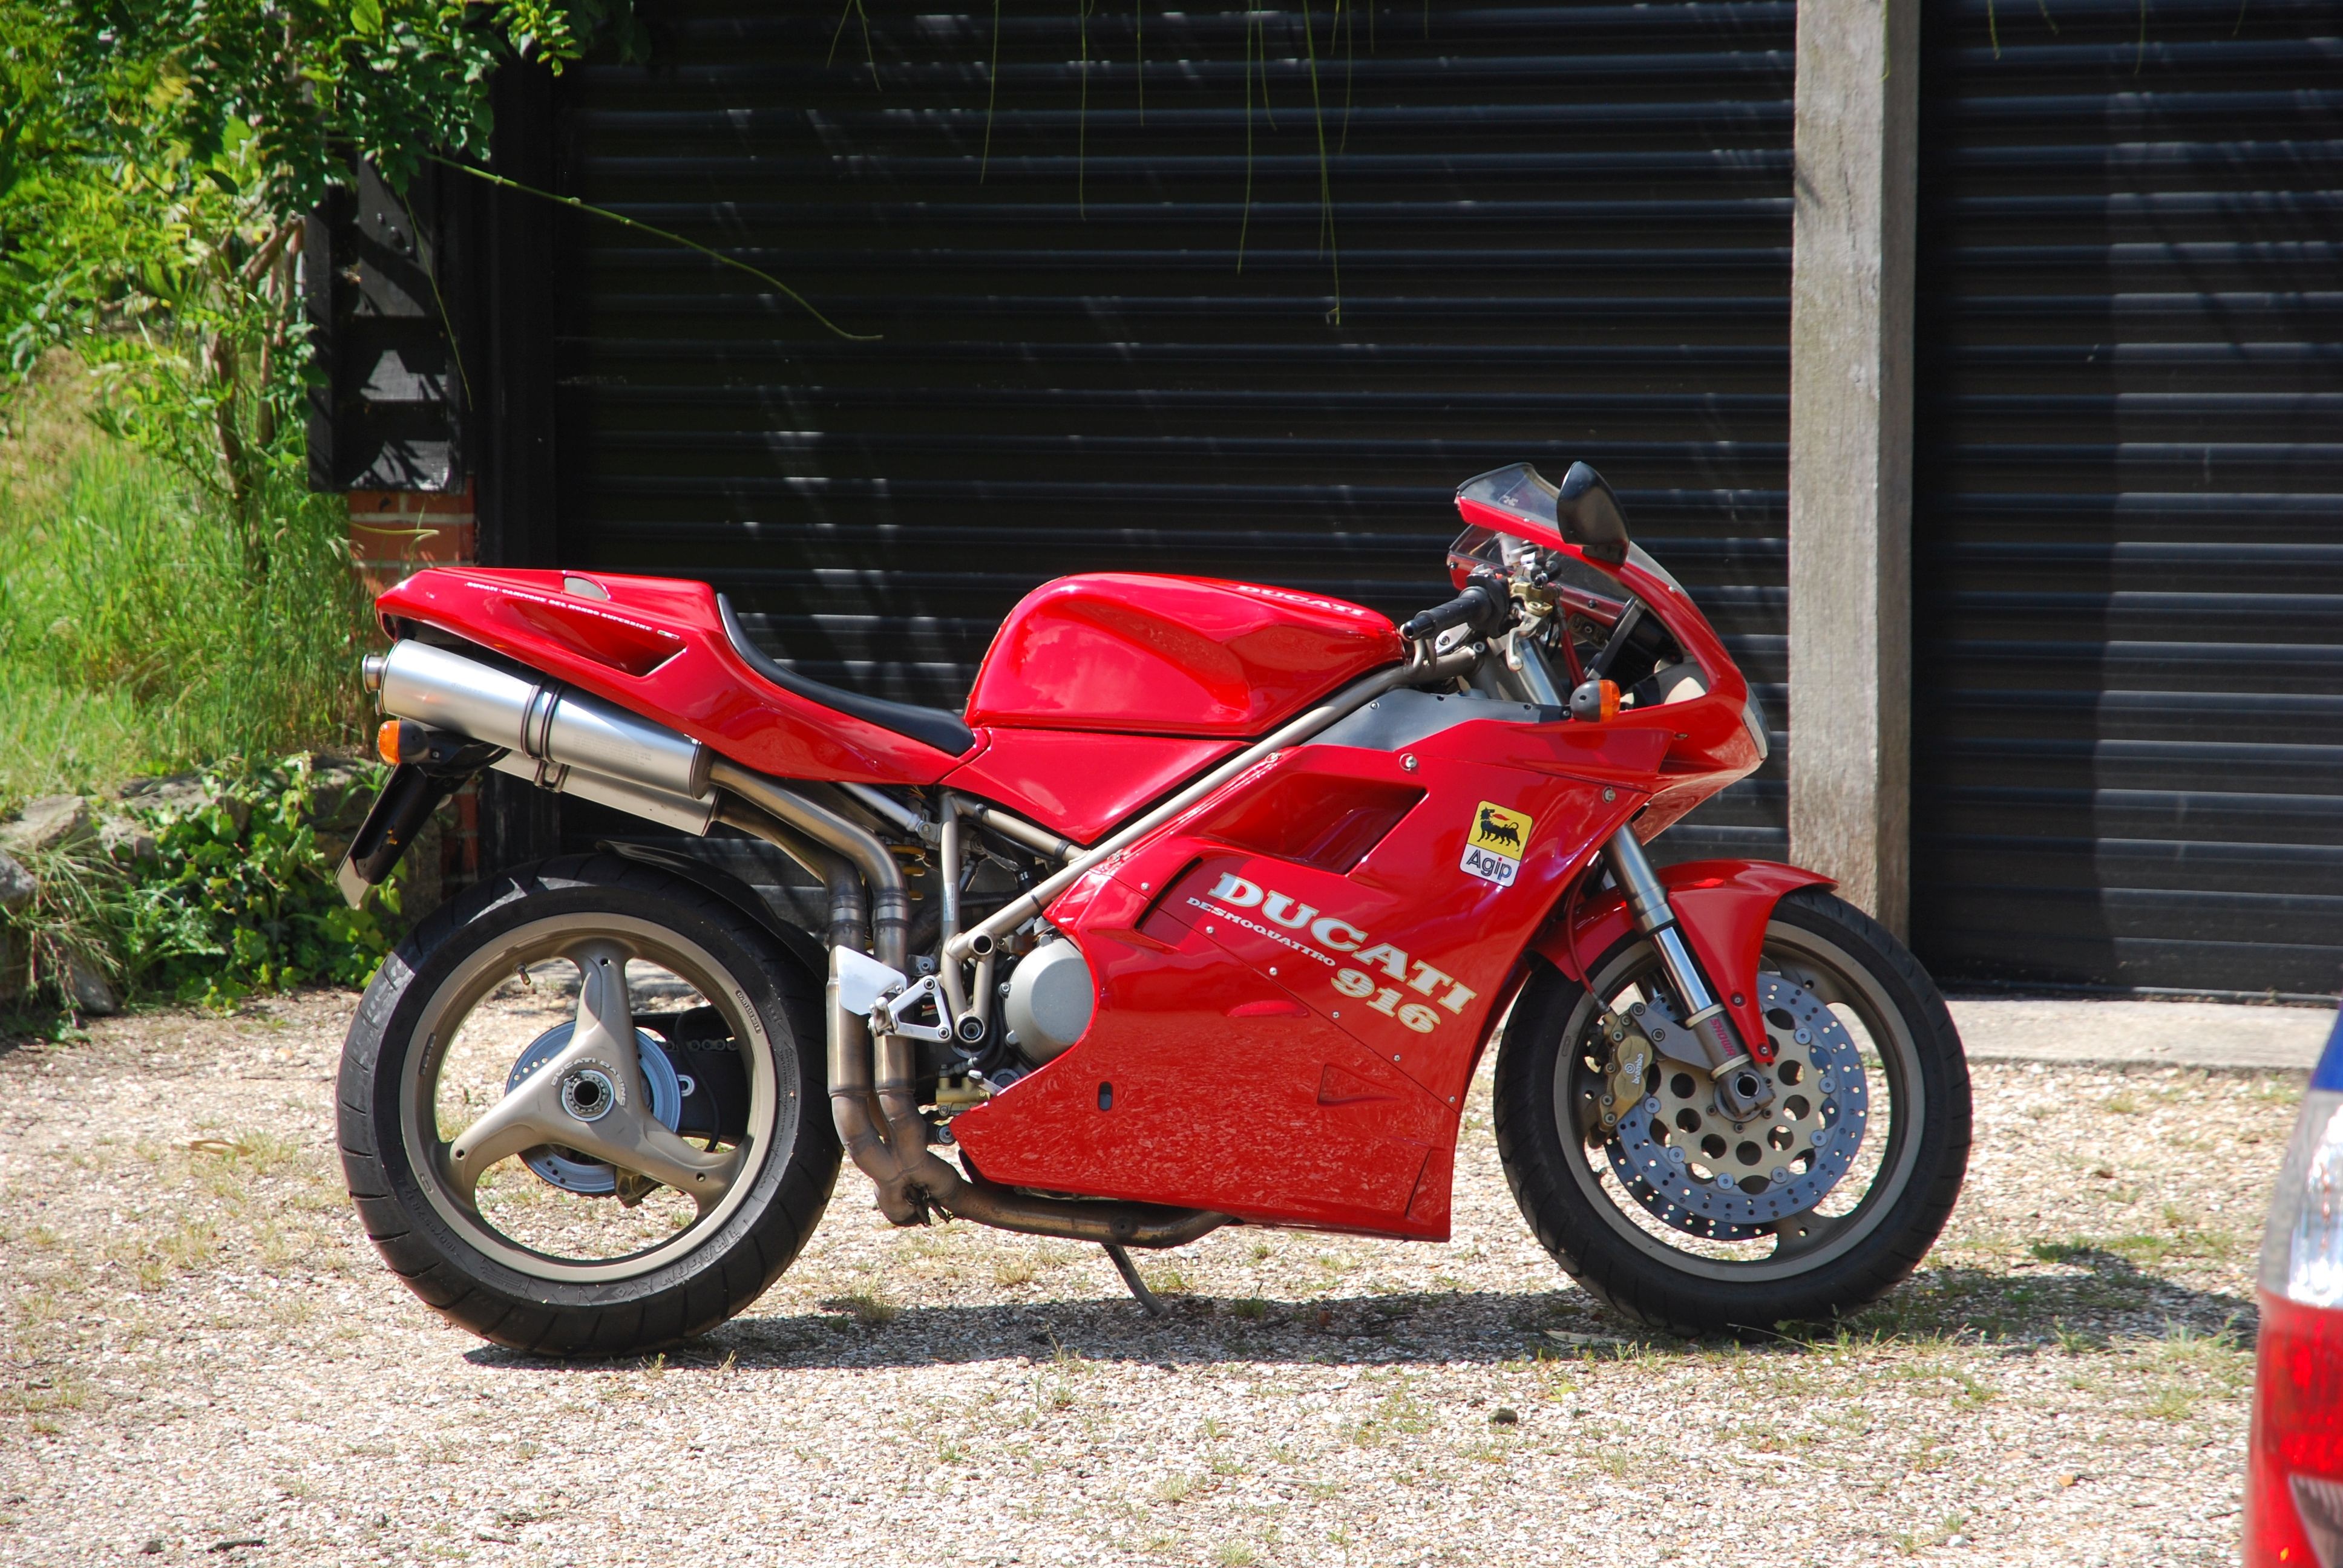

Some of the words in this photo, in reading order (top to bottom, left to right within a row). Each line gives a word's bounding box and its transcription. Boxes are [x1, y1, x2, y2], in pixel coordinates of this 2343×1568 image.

[1236, 584, 1366, 616] DUCATI
[1466, 849, 1512, 881] Agip
[1186, 897, 1336, 967] DESMOQUATTRO
[1207, 871, 1477, 1015] DUCATI
[1331, 967, 1441, 1033] 916
[1710, 1017, 1736, 1057] SHOWA
[551, 1057, 596, 1086] DUCATI
[600, 1060, 626, 1106] RACING
[1631, 1053, 1644, 1085] brembo
